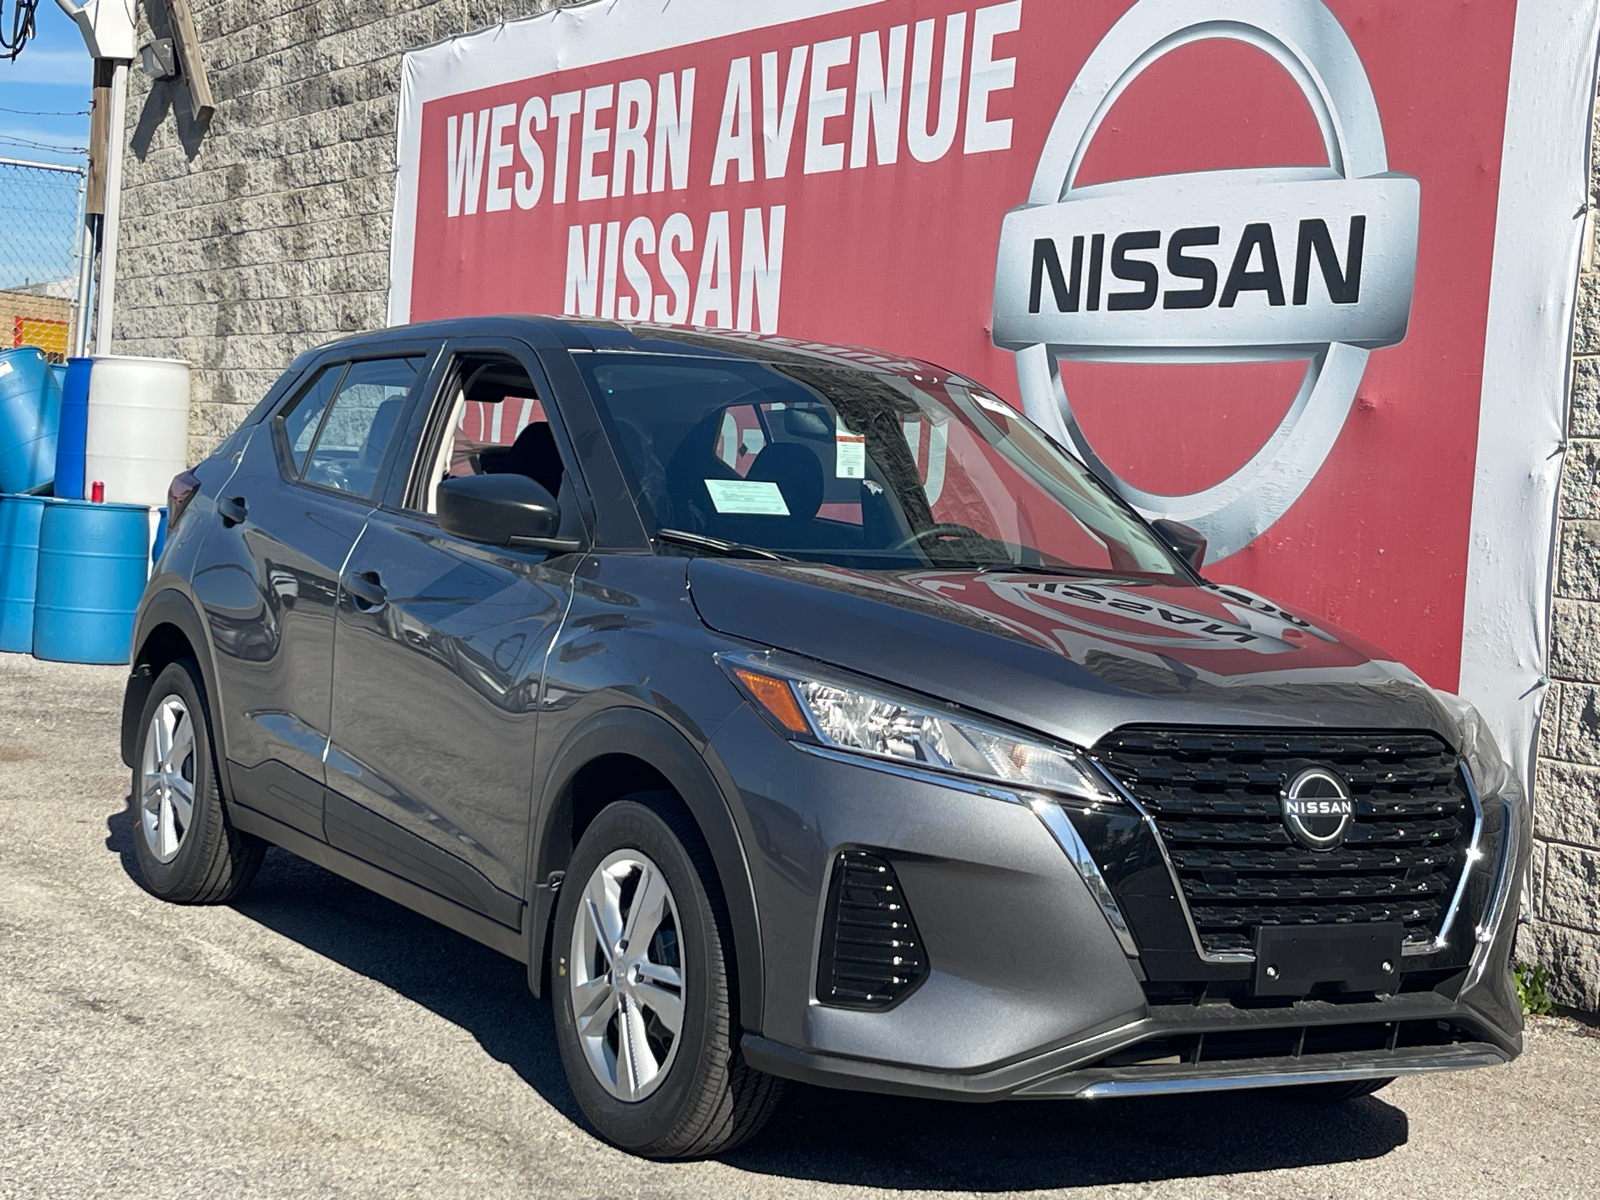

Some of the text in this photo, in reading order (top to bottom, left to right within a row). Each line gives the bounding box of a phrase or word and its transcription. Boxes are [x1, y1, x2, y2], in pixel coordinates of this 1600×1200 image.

[447, 0, 1022, 218] WESTERN AVENUE
[564, 205, 786, 334] NISSAN
[1029, 215, 1366, 314] NISSAN
[1286, 801, 1352, 814] NISSAN
